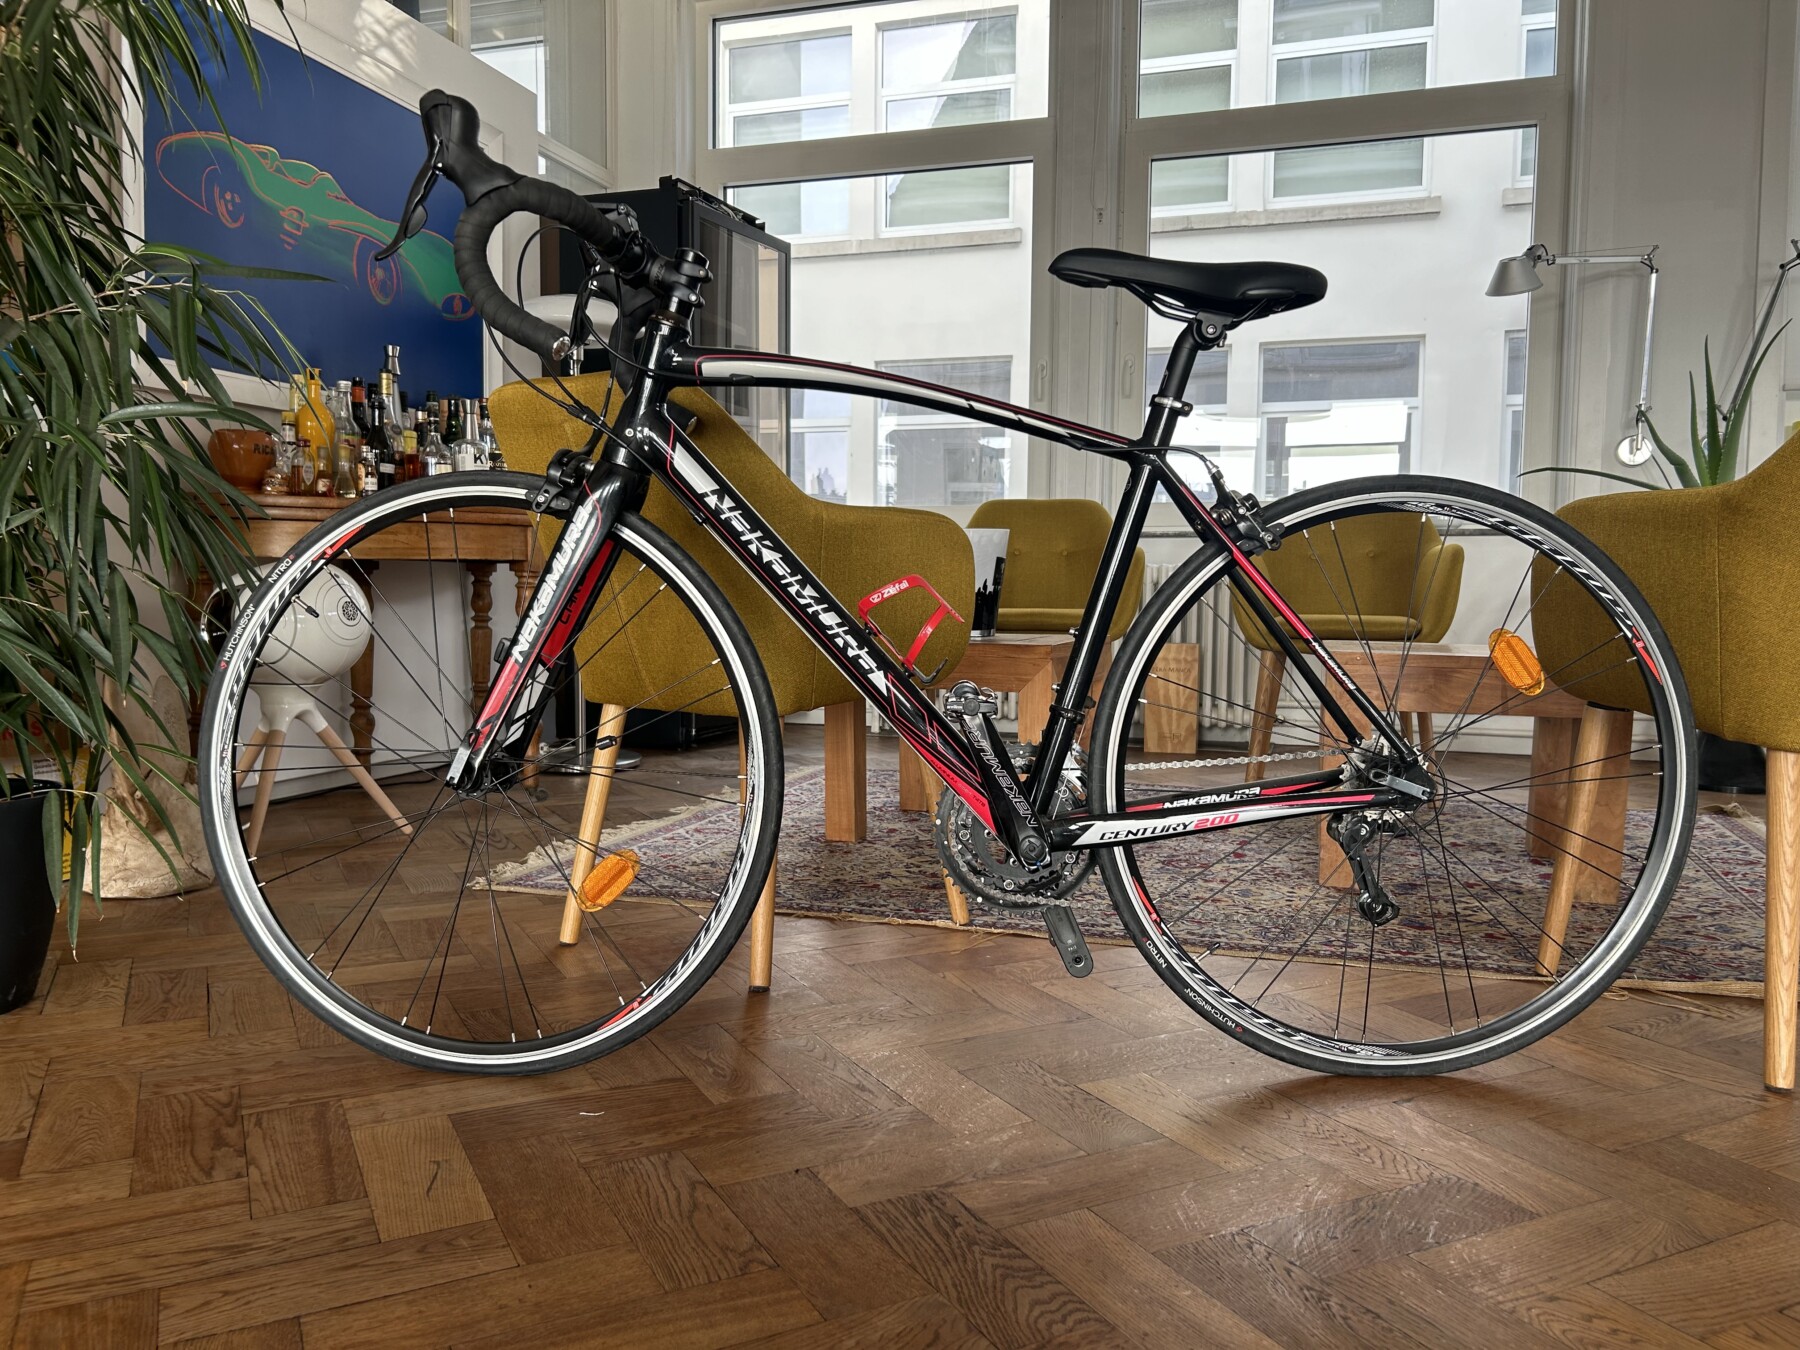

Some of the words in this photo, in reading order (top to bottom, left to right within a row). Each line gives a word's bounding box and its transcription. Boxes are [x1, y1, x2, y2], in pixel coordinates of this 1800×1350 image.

[268, 558, 292, 584] NITRO
[511, 504, 592, 663] NAKAMURA
[224, 603, 256, 662] HUTCHINSON
[1163, 786, 1260, 808] NAKAMURA
[1099, 820, 1195, 841] CENTURY
[1194, 813, 1240, 829] 200
[1145, 940, 1168, 969] NITRO
[1185, 988, 1236, 1029] HUTCHINSON
